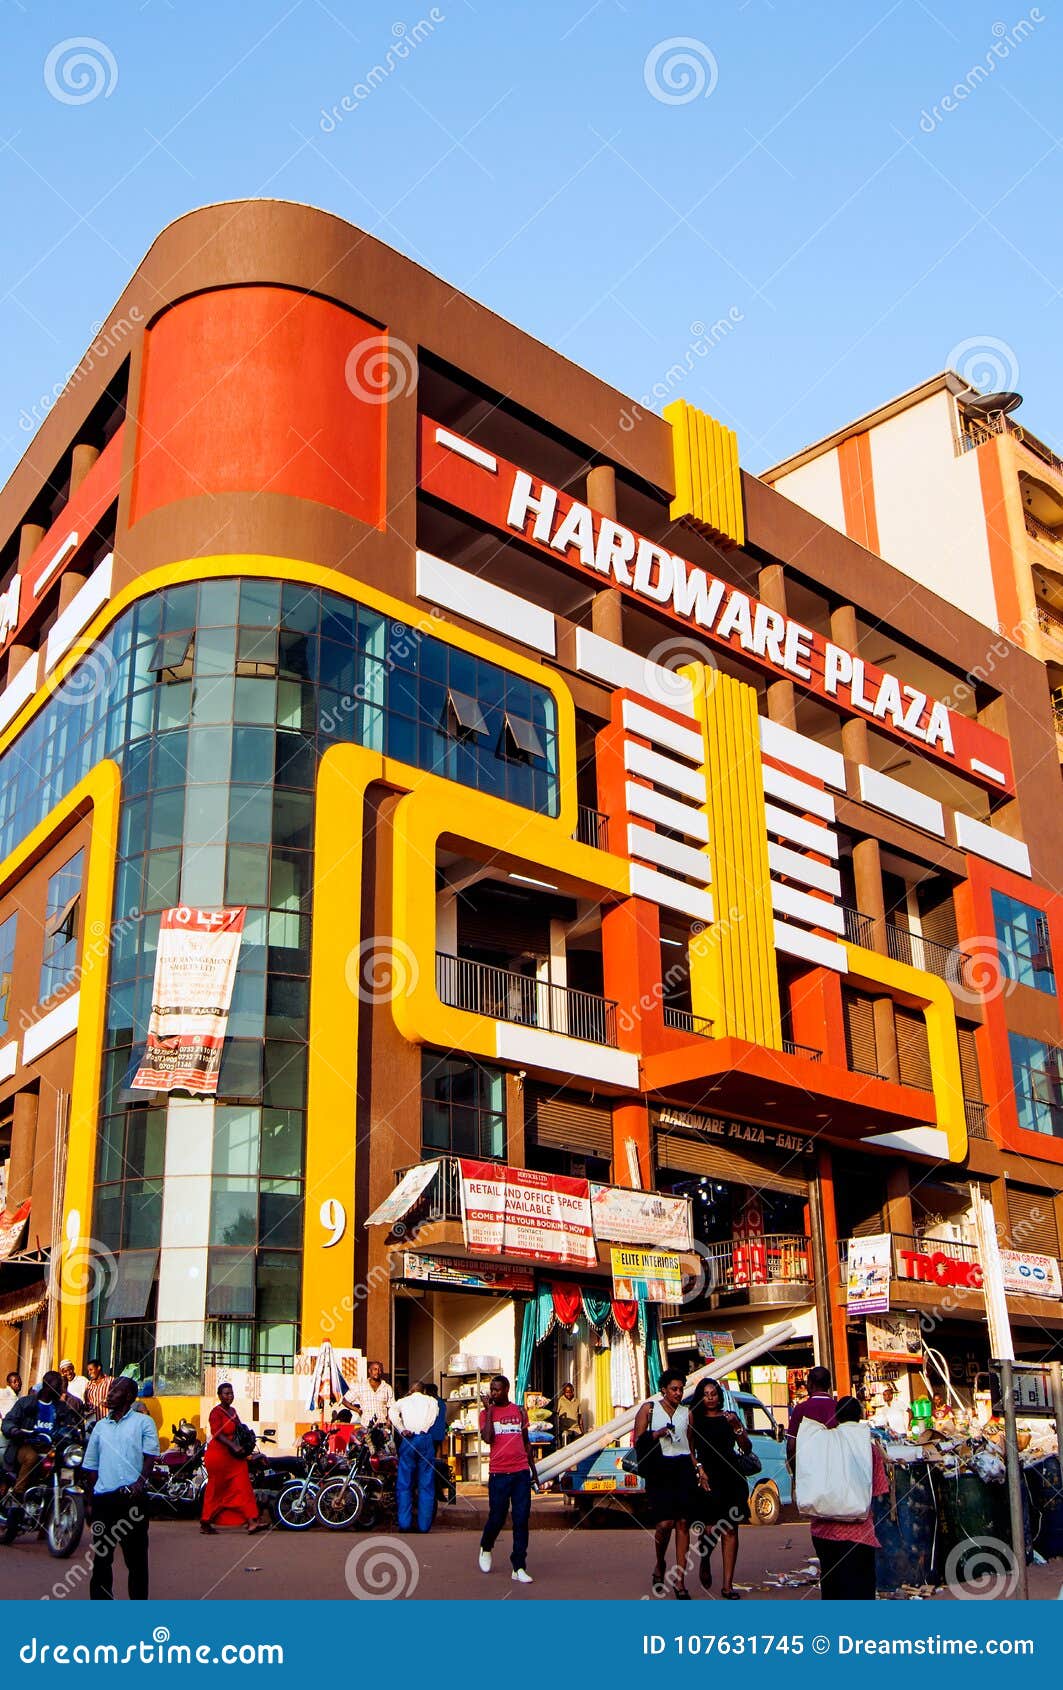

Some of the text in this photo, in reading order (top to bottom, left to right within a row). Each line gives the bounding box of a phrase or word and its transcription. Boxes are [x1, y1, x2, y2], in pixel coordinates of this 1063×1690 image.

[506, 469, 955, 756] HARDWARE PLAZA
[659, 1108, 725, 1135] HARDWARE
[806, 1142, 814, 1153] 3
[469, 1184, 583, 1210] RETAIL AND OFFICE SPACE
[505, 1199, 552, 1216] AVAILABLE
[320, 1198, 346, 1248] 9
[471, 1211, 494, 1221] COME
[496, 1213, 516, 1224] MKE
[569, 1225, 585, 1234] NOW
[621, 1253, 679, 1269] ELITE INTERIORS
